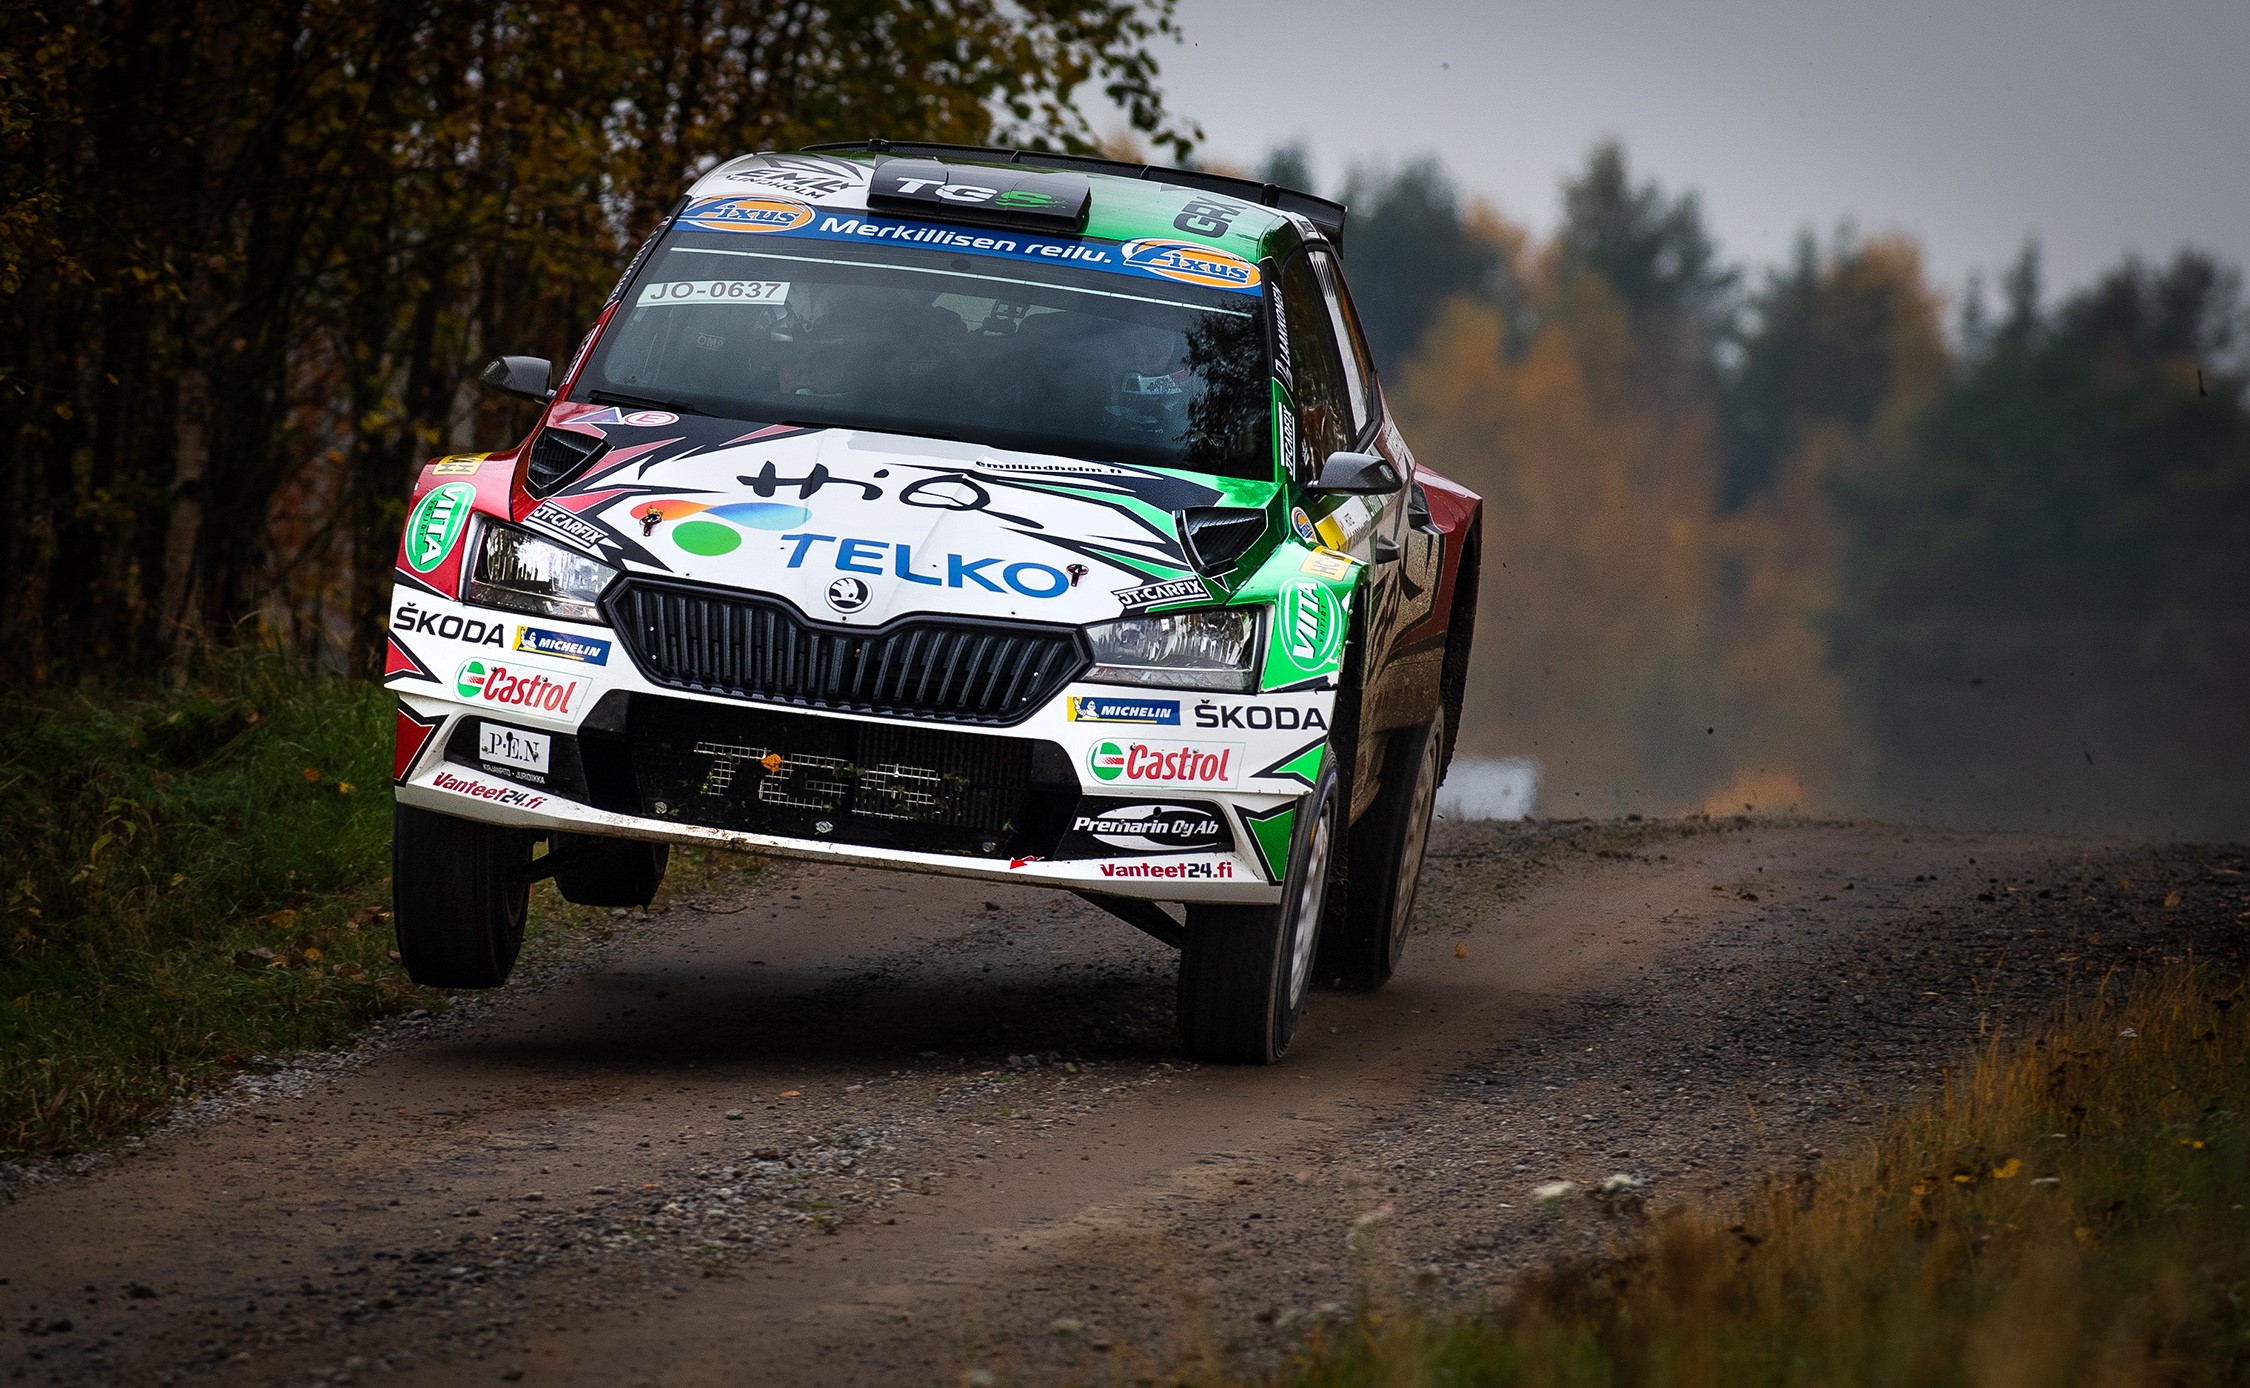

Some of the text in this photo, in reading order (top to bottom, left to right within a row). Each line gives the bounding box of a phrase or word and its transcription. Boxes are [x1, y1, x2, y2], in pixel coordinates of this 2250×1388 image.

[726, 175, 827, 199] LINDHOLM
[819, 216, 1111, 264] Merkillisen reilu.
[650, 281, 781, 300] JO-0637
[780, 533, 1070, 598] TELKO
[393, 602, 505, 649] ŠKODA
[538, 637, 602, 658] MICHELIN
[483, 666, 577, 714] Castrol
[1100, 704, 1173, 719] MICHELIN
[1194, 699, 1328, 731] ŠKODA
[1126, 744, 1231, 782] Castrol
[432, 771, 547, 810] Vanteet24.fi
[1072, 816, 1220, 838] Premarin Oy Ab
[1100, 862, 1233, 879] Vanteet24.fi
